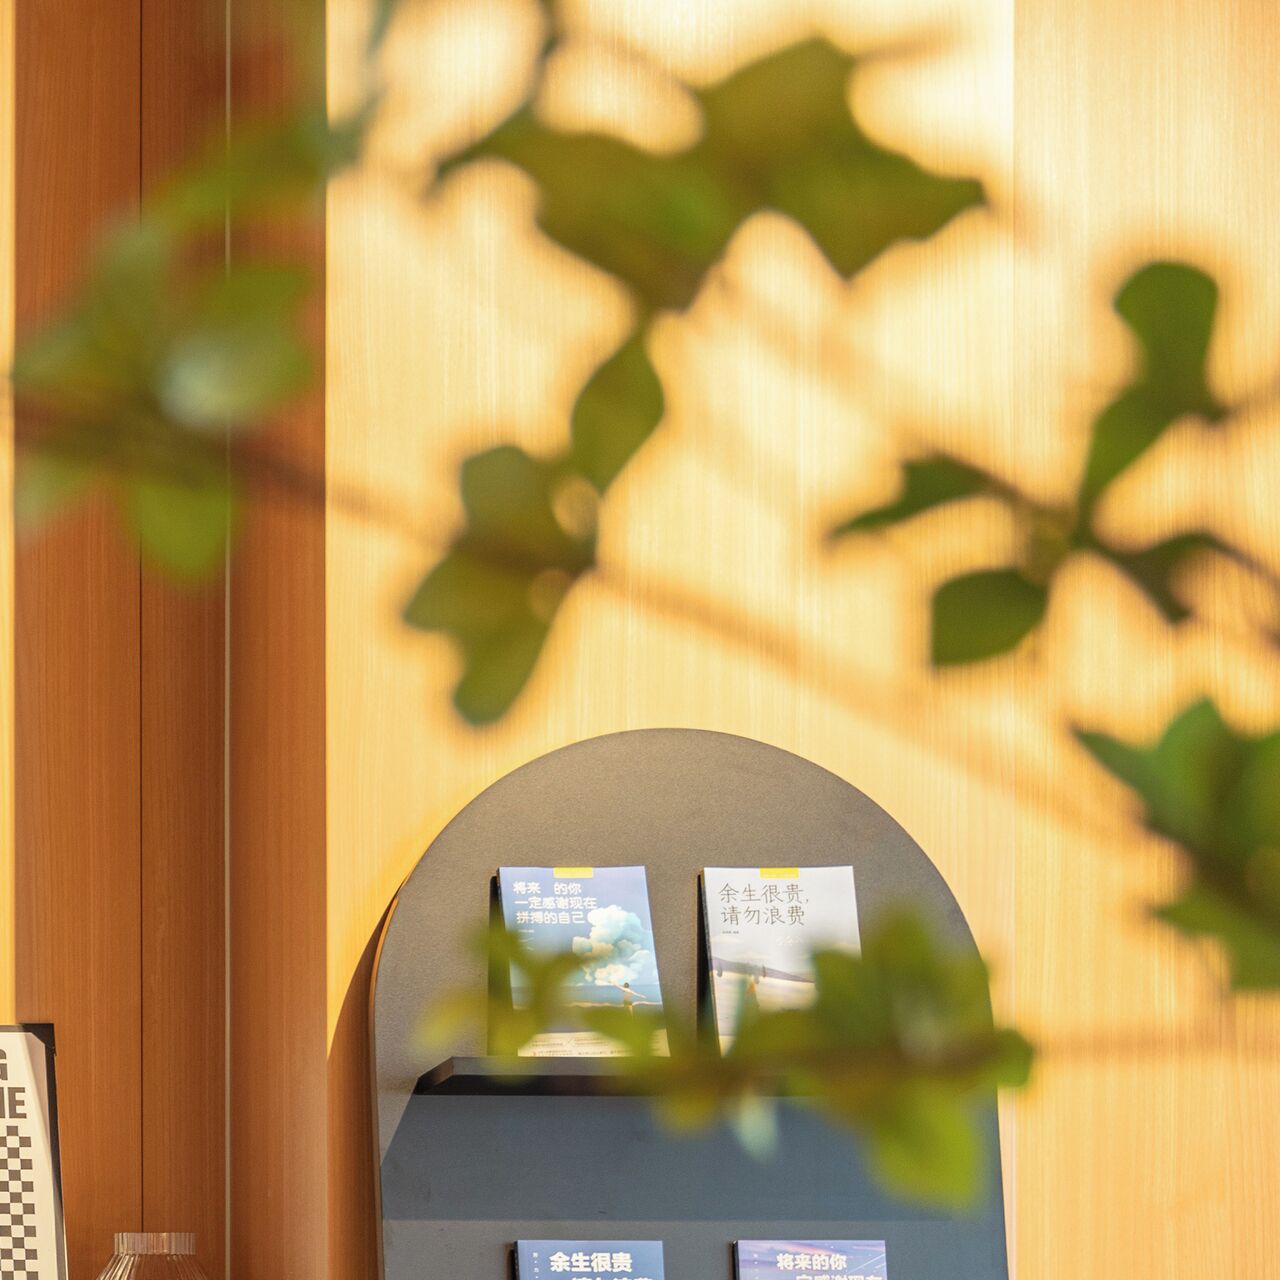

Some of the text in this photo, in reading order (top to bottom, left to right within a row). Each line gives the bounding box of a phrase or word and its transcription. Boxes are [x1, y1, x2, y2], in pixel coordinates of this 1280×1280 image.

[554, 882, 582, 895] 的你
[721, 905, 805, 926] 请勿浪费
[549, 1251, 633, 1273] 余生很贵
[776, 1253, 847, 1271] 将来的你
